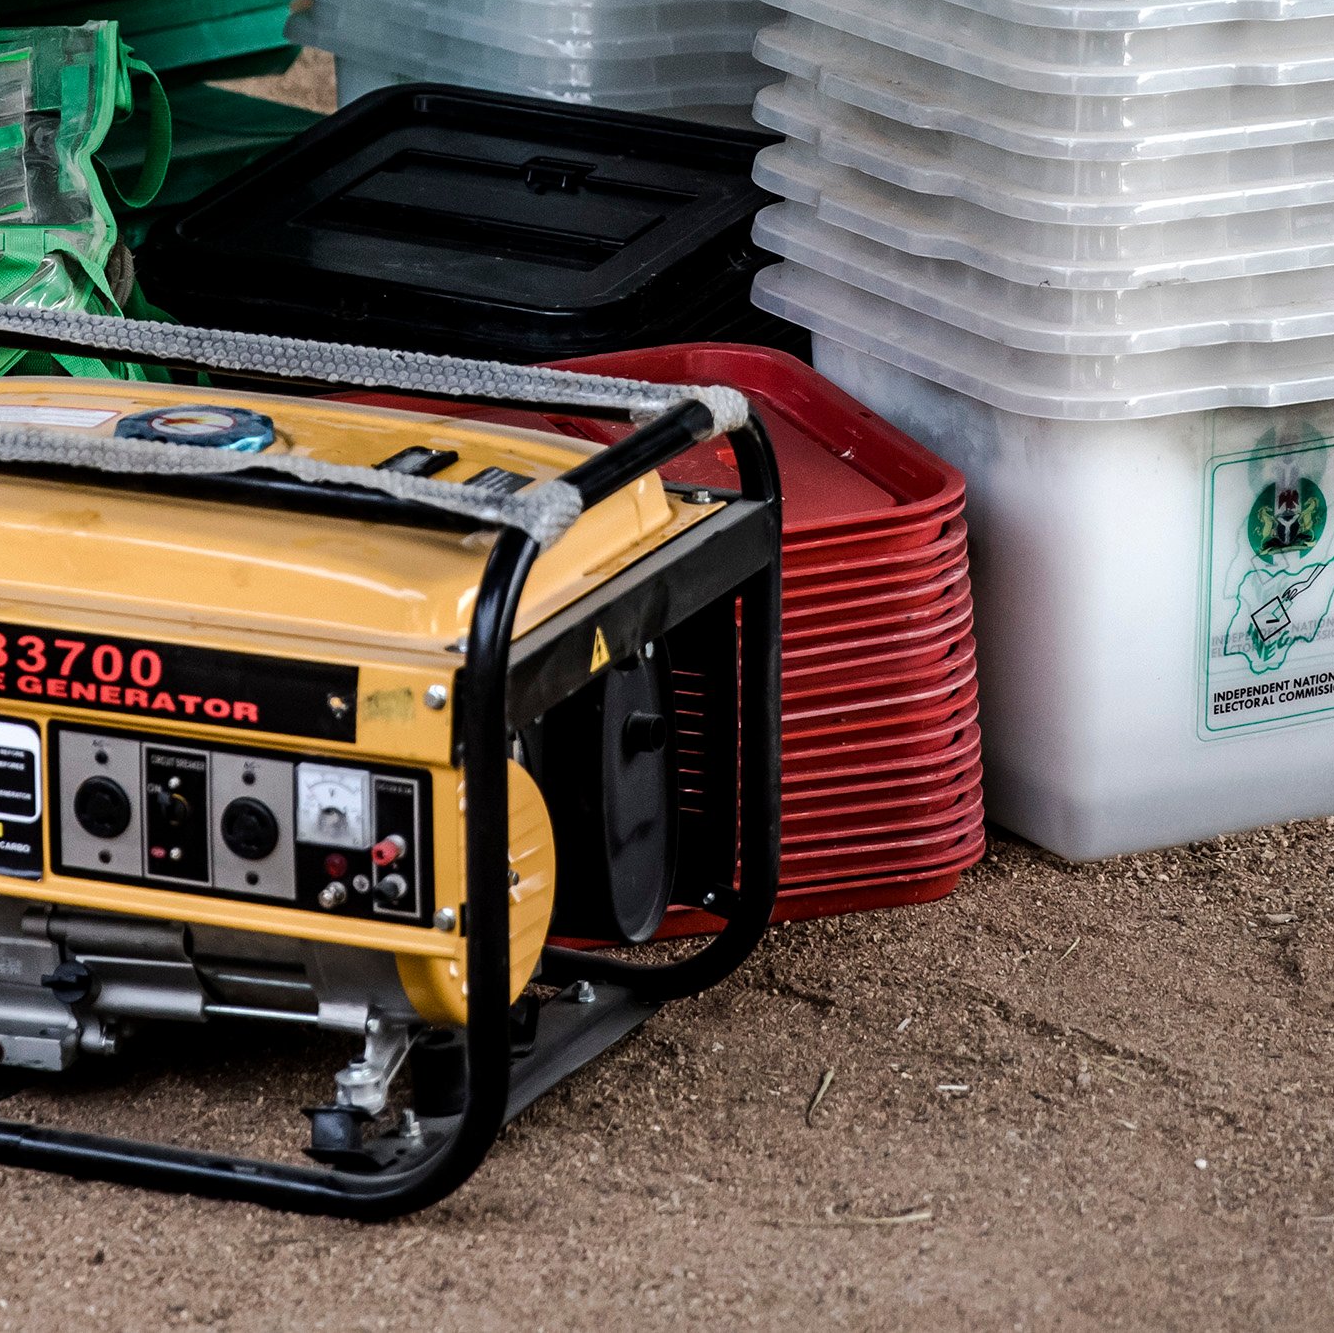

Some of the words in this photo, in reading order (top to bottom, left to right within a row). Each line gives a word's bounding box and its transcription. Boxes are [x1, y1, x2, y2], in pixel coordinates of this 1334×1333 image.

[16, 675, 259, 723] GENERATOR
[1213, 679, 1290, 703] INDEPENDENT
[1213, 694, 1275, 715] ELECTORAL
